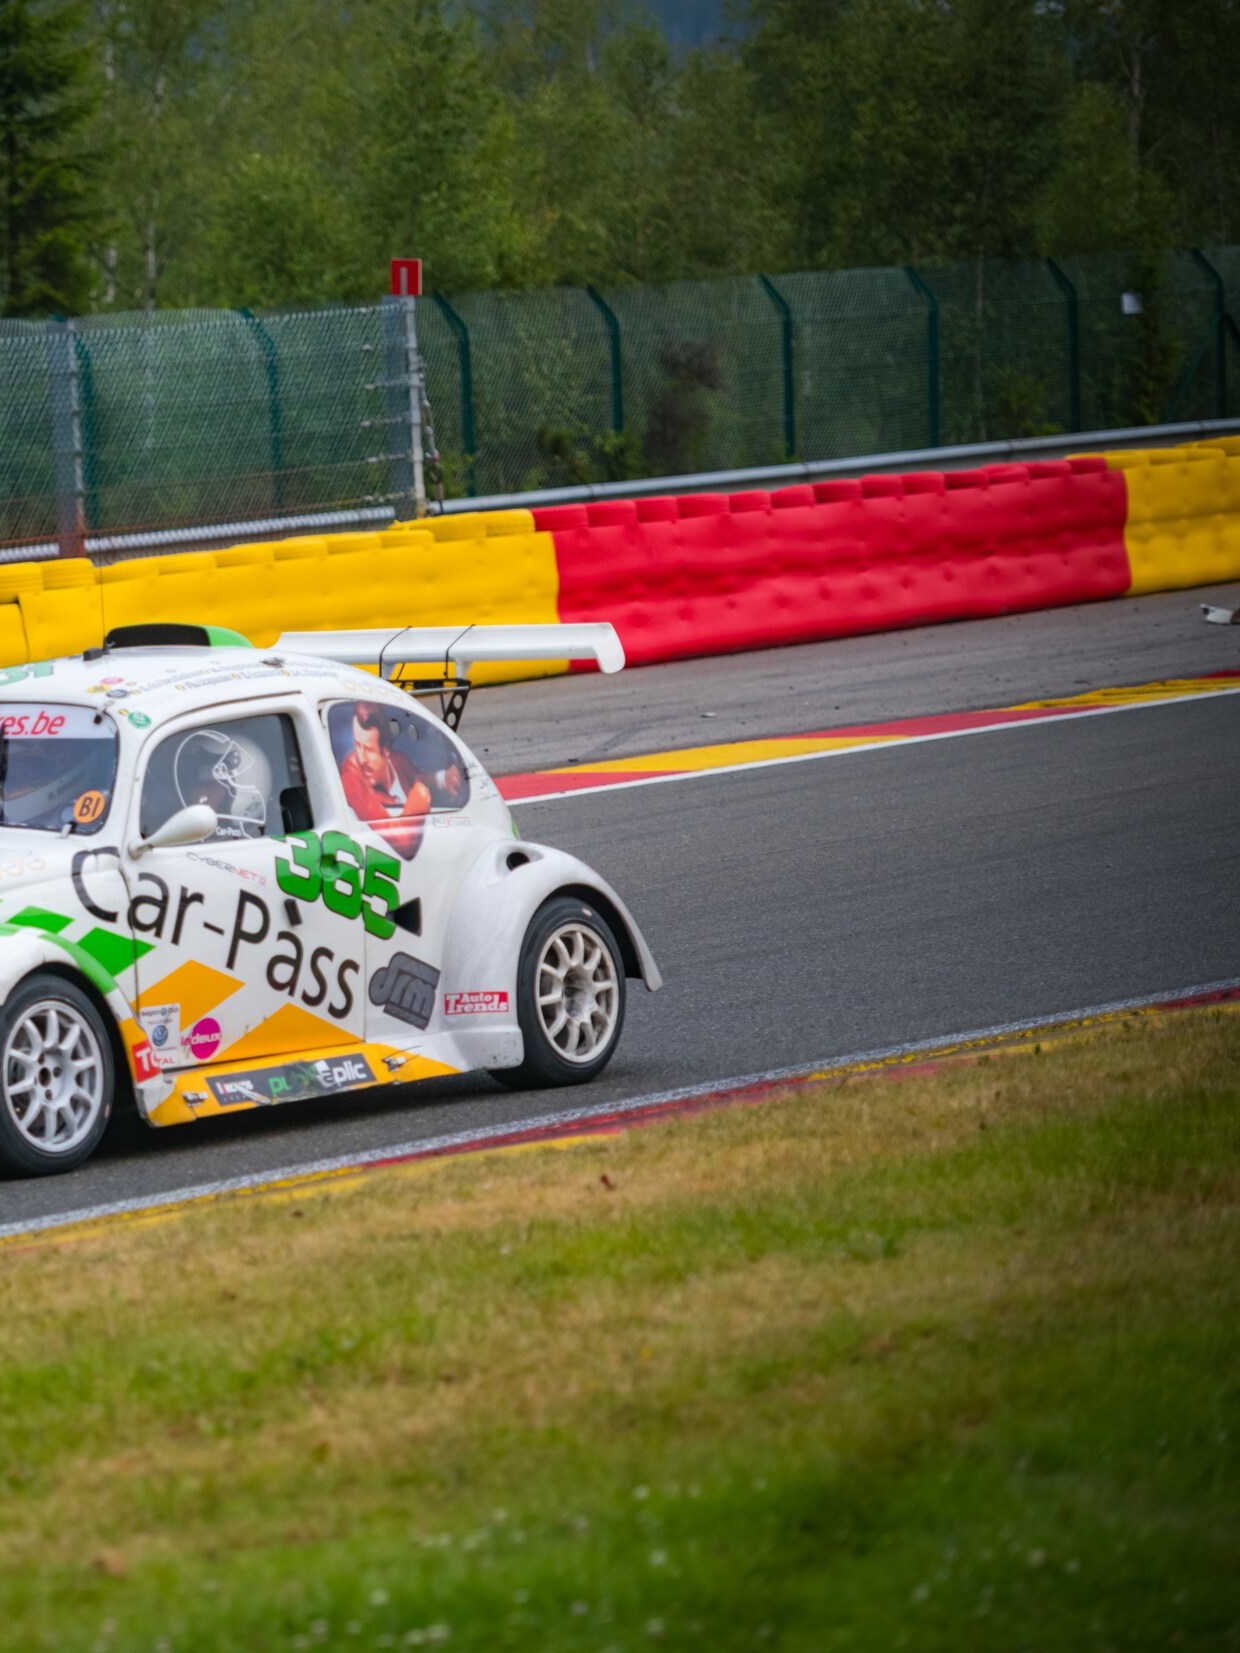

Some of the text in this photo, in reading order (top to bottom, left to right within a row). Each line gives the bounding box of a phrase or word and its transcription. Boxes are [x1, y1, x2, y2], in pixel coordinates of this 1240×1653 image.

[270, 830, 402, 941] 365
[71, 845, 361, 1020] Car-Pass
[446, 993, 508, 1015] Trends
[459, 993, 493, 1003] Auto
